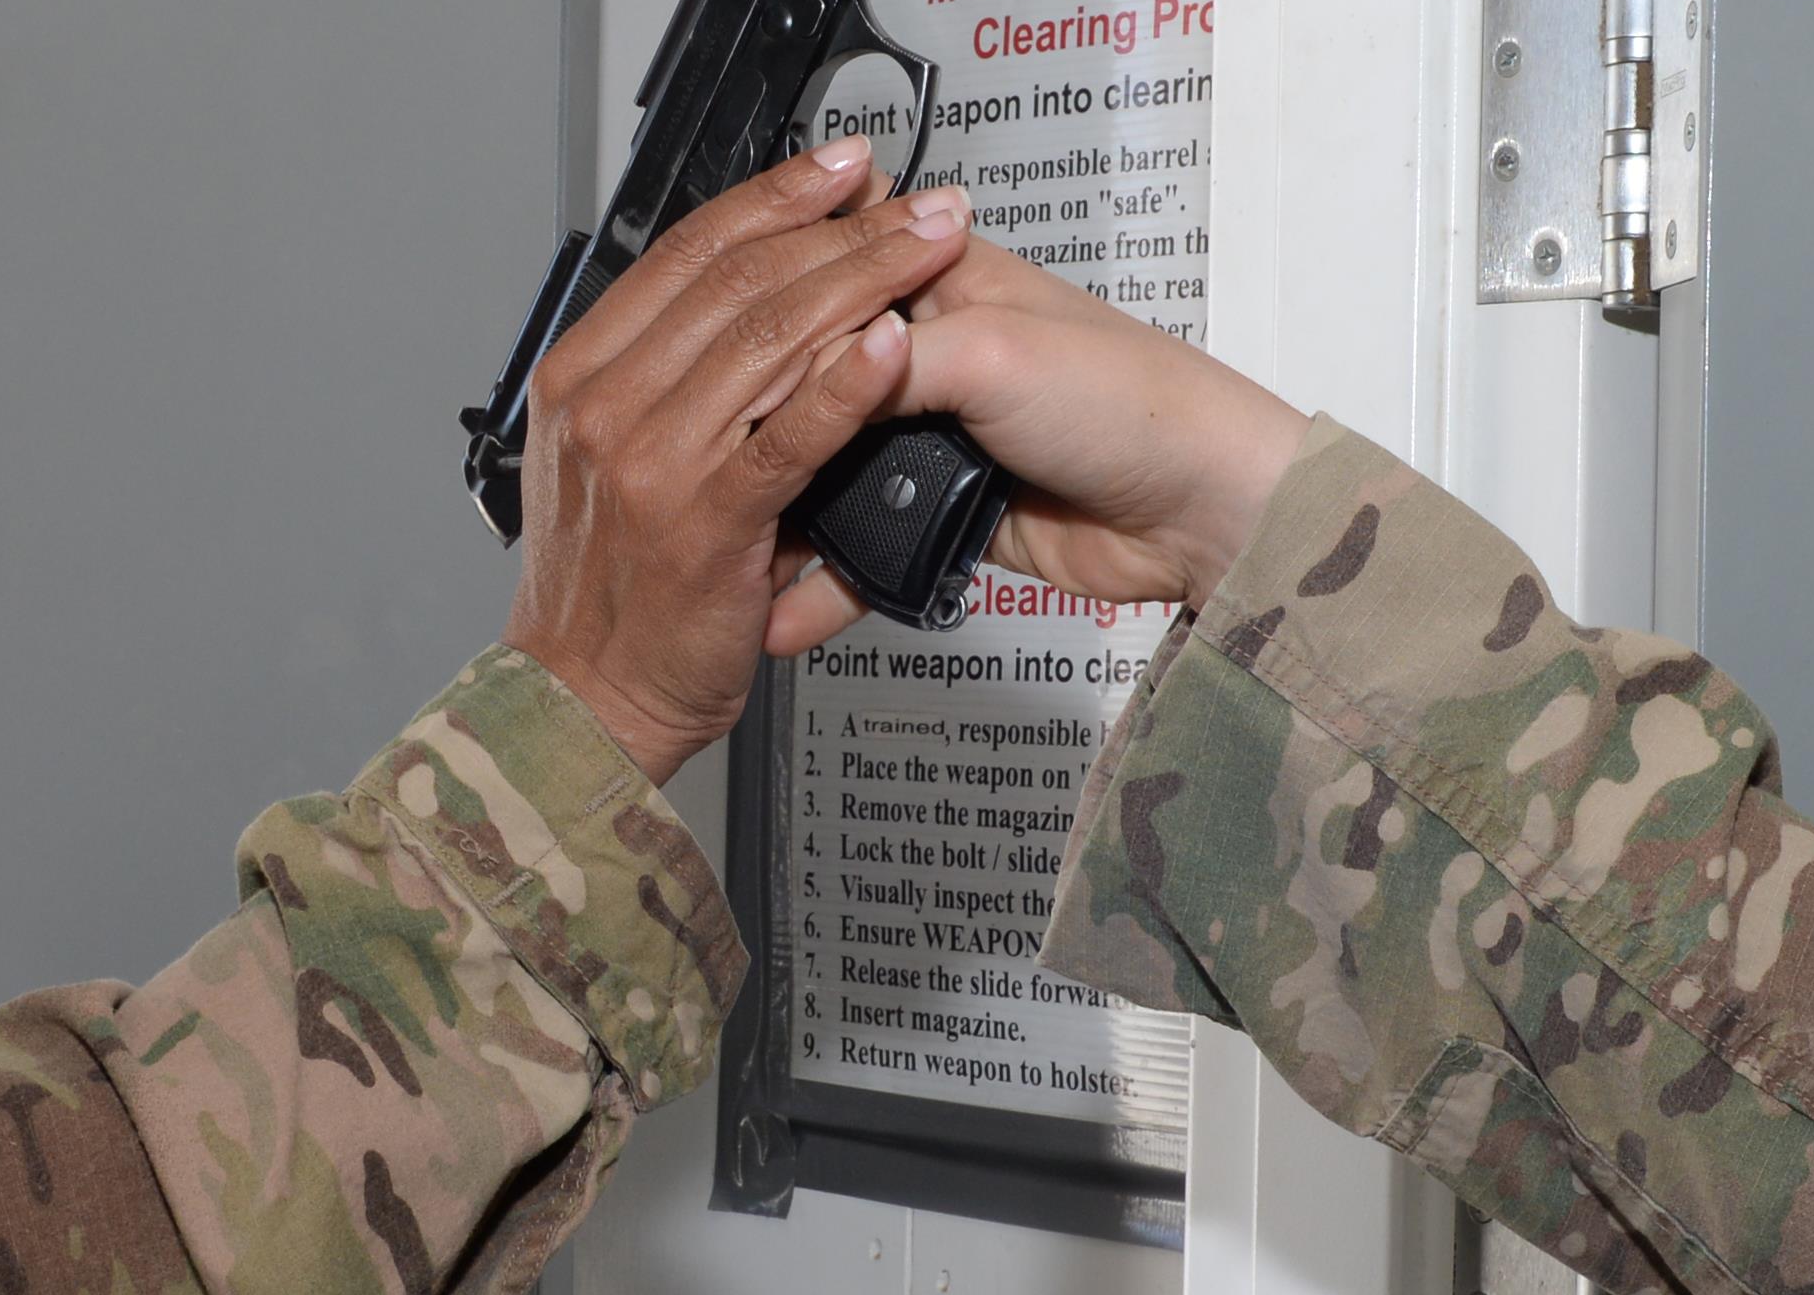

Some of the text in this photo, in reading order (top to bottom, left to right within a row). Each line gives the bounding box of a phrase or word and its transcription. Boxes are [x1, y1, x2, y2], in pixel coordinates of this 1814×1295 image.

[973, 6, 1136, 60] Clearing
[825, 103, 896, 141] Point
[1033, 82, 1092, 118] into
[977, 148, 1111, 190] responsible
[1120, 139, 1197, 173] barrel
[1060, 198, 1089, 221] on
[1008, 235, 1106, 268] agazine
[1115, 231, 1176, 260] from
[1117, 274, 1156, 303] the
[1164, 278, 1208, 301] rea
[807, 644, 880, 678] Point
[888, 652, 1003, 688] weapon
[1014, 647, 1074, 683] into
[806, 709, 823, 736] 1.
[840, 712, 858, 738] A
[863, 718, 951, 747] trained,
[958, 718, 1092, 751] responsible
[804, 750, 822, 777] 2.
[841, 751, 898, 781] Place
[905, 755, 939, 783] the
[946, 763, 1033, 794] weapon
[1041, 768, 1070, 790] on
[803, 790, 821, 818] 3.
[840, 792, 927, 824] Remove
[934, 798, 969, 827] the
[803, 831, 821, 858] 4.
[840, 833, 894, 864] Lock
[901, 838, 935, 866] the
[942, 840, 986, 870] bolt
[1008, 845, 1061, 875] slide
[803, 871, 821, 898] 5.
[840, 874, 927, 915] Visually
[934, 882, 1015, 919] inspect
[803, 912, 1043, 958] 6. Ensure WEAPON
[804, 952, 822, 979] 7.
[840, 955, 921, 989] Release
[928, 965, 963, 993] the
[970, 968, 1023, 999] slide
[804, 992, 1026, 1043] 8. Insert magazine.
[803, 1032, 1139, 1098] 9. Return weapon to holster.
